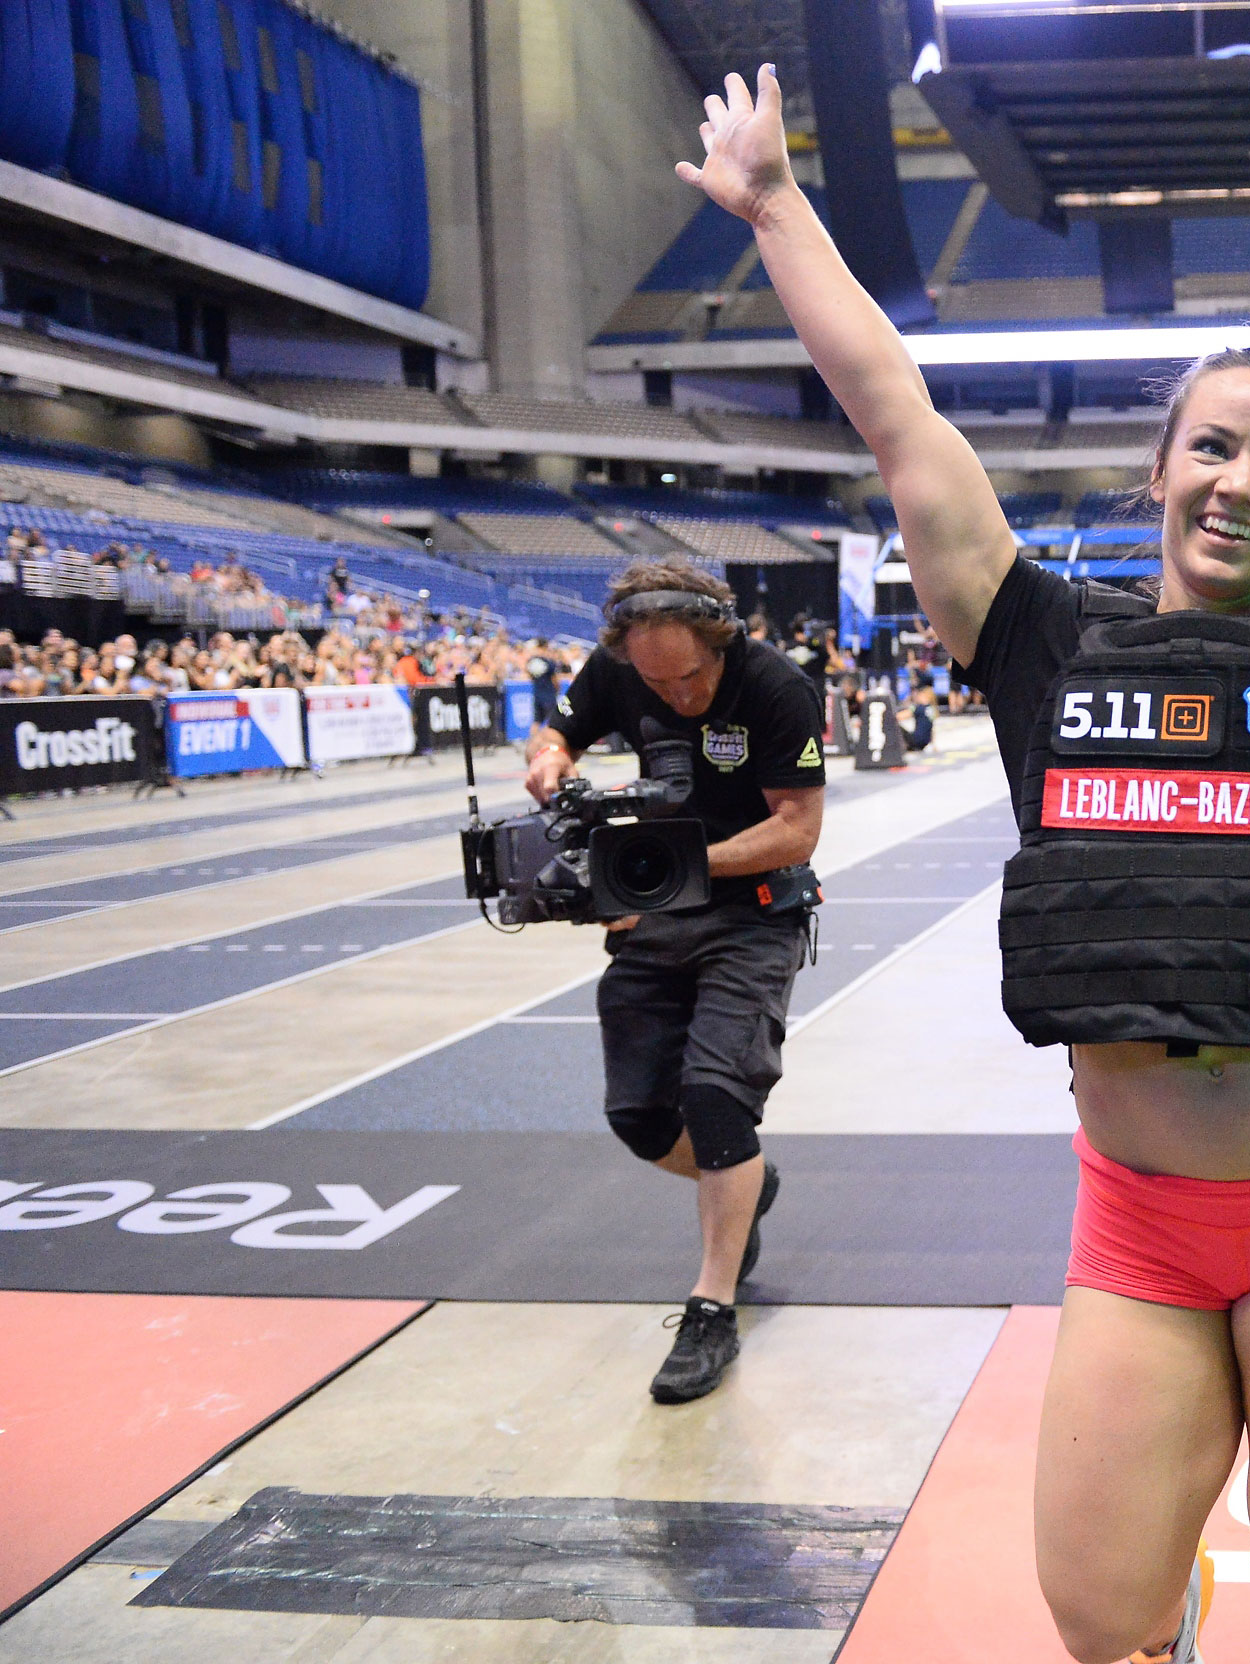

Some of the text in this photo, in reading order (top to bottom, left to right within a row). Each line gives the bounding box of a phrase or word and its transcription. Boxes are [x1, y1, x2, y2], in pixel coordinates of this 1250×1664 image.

[179, 719, 239, 756] EVENT
[1059, 691, 1156, 739] 5.11
[15, 717, 138, 771] CrossFit
[0, 1179, 463, 1250] Ree
